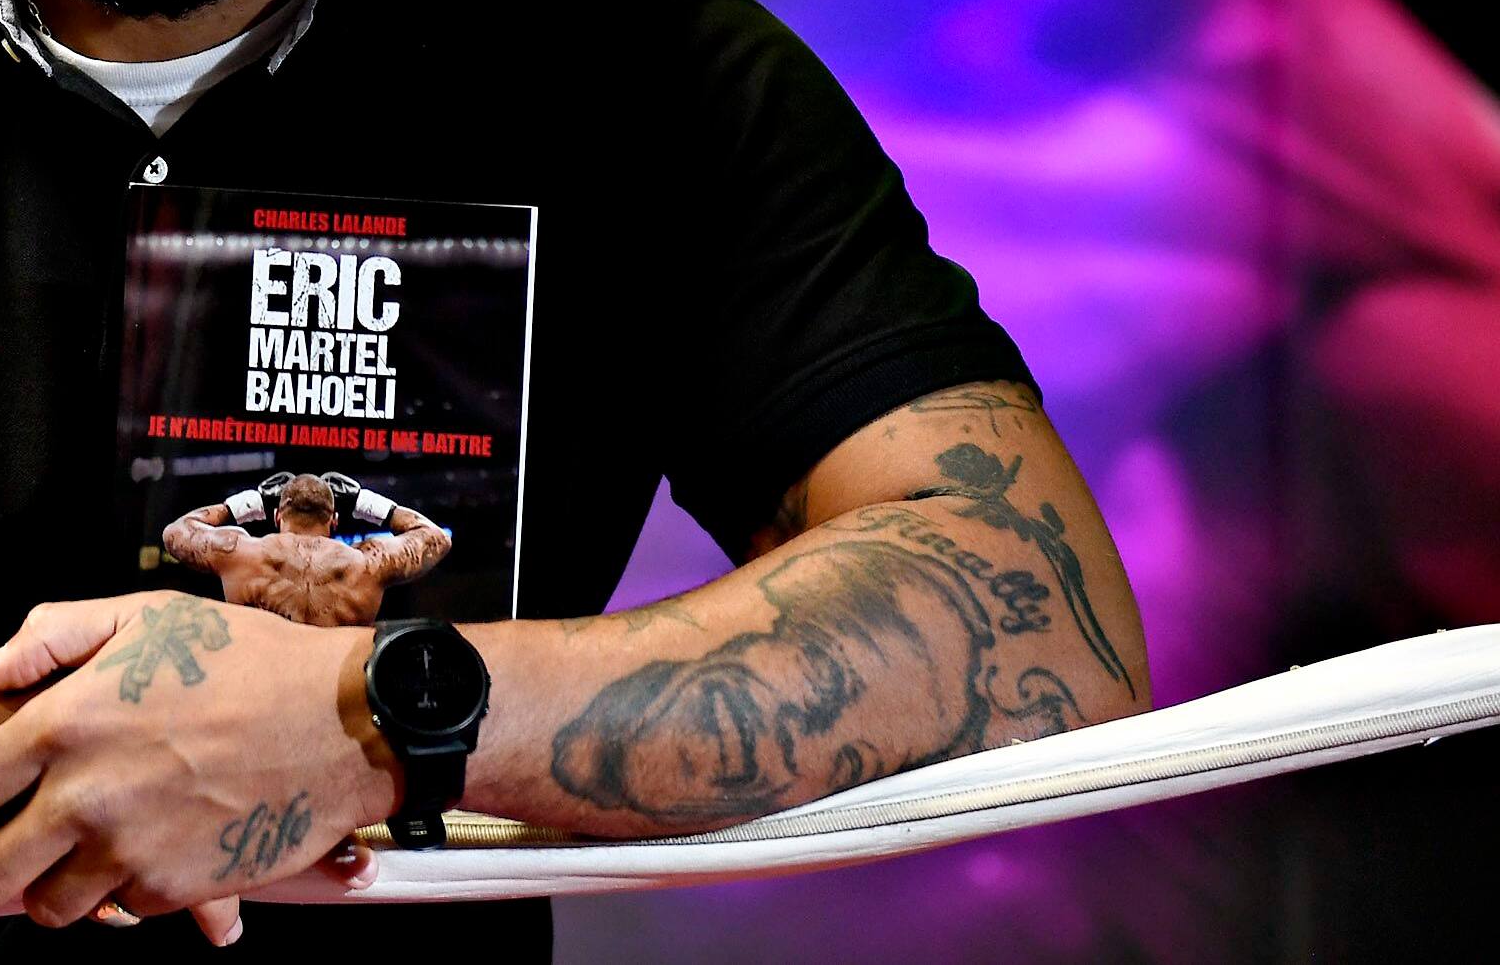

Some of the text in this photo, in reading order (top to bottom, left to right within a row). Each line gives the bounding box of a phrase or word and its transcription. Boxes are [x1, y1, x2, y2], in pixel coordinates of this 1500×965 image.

[253, 208, 407, 236] CHARLES LALANDE
[248, 327, 397, 376] MARTEL
[245, 370, 397, 419] BAHOELI
[148, 415, 166, 437] JE
[290, 424, 359, 449] JAMAIS
[363, 428, 388, 451] DE
[391, 430, 419, 452] ME
[421, 432, 492, 457] BATTRE
[211, 790, 313, 882] Life
